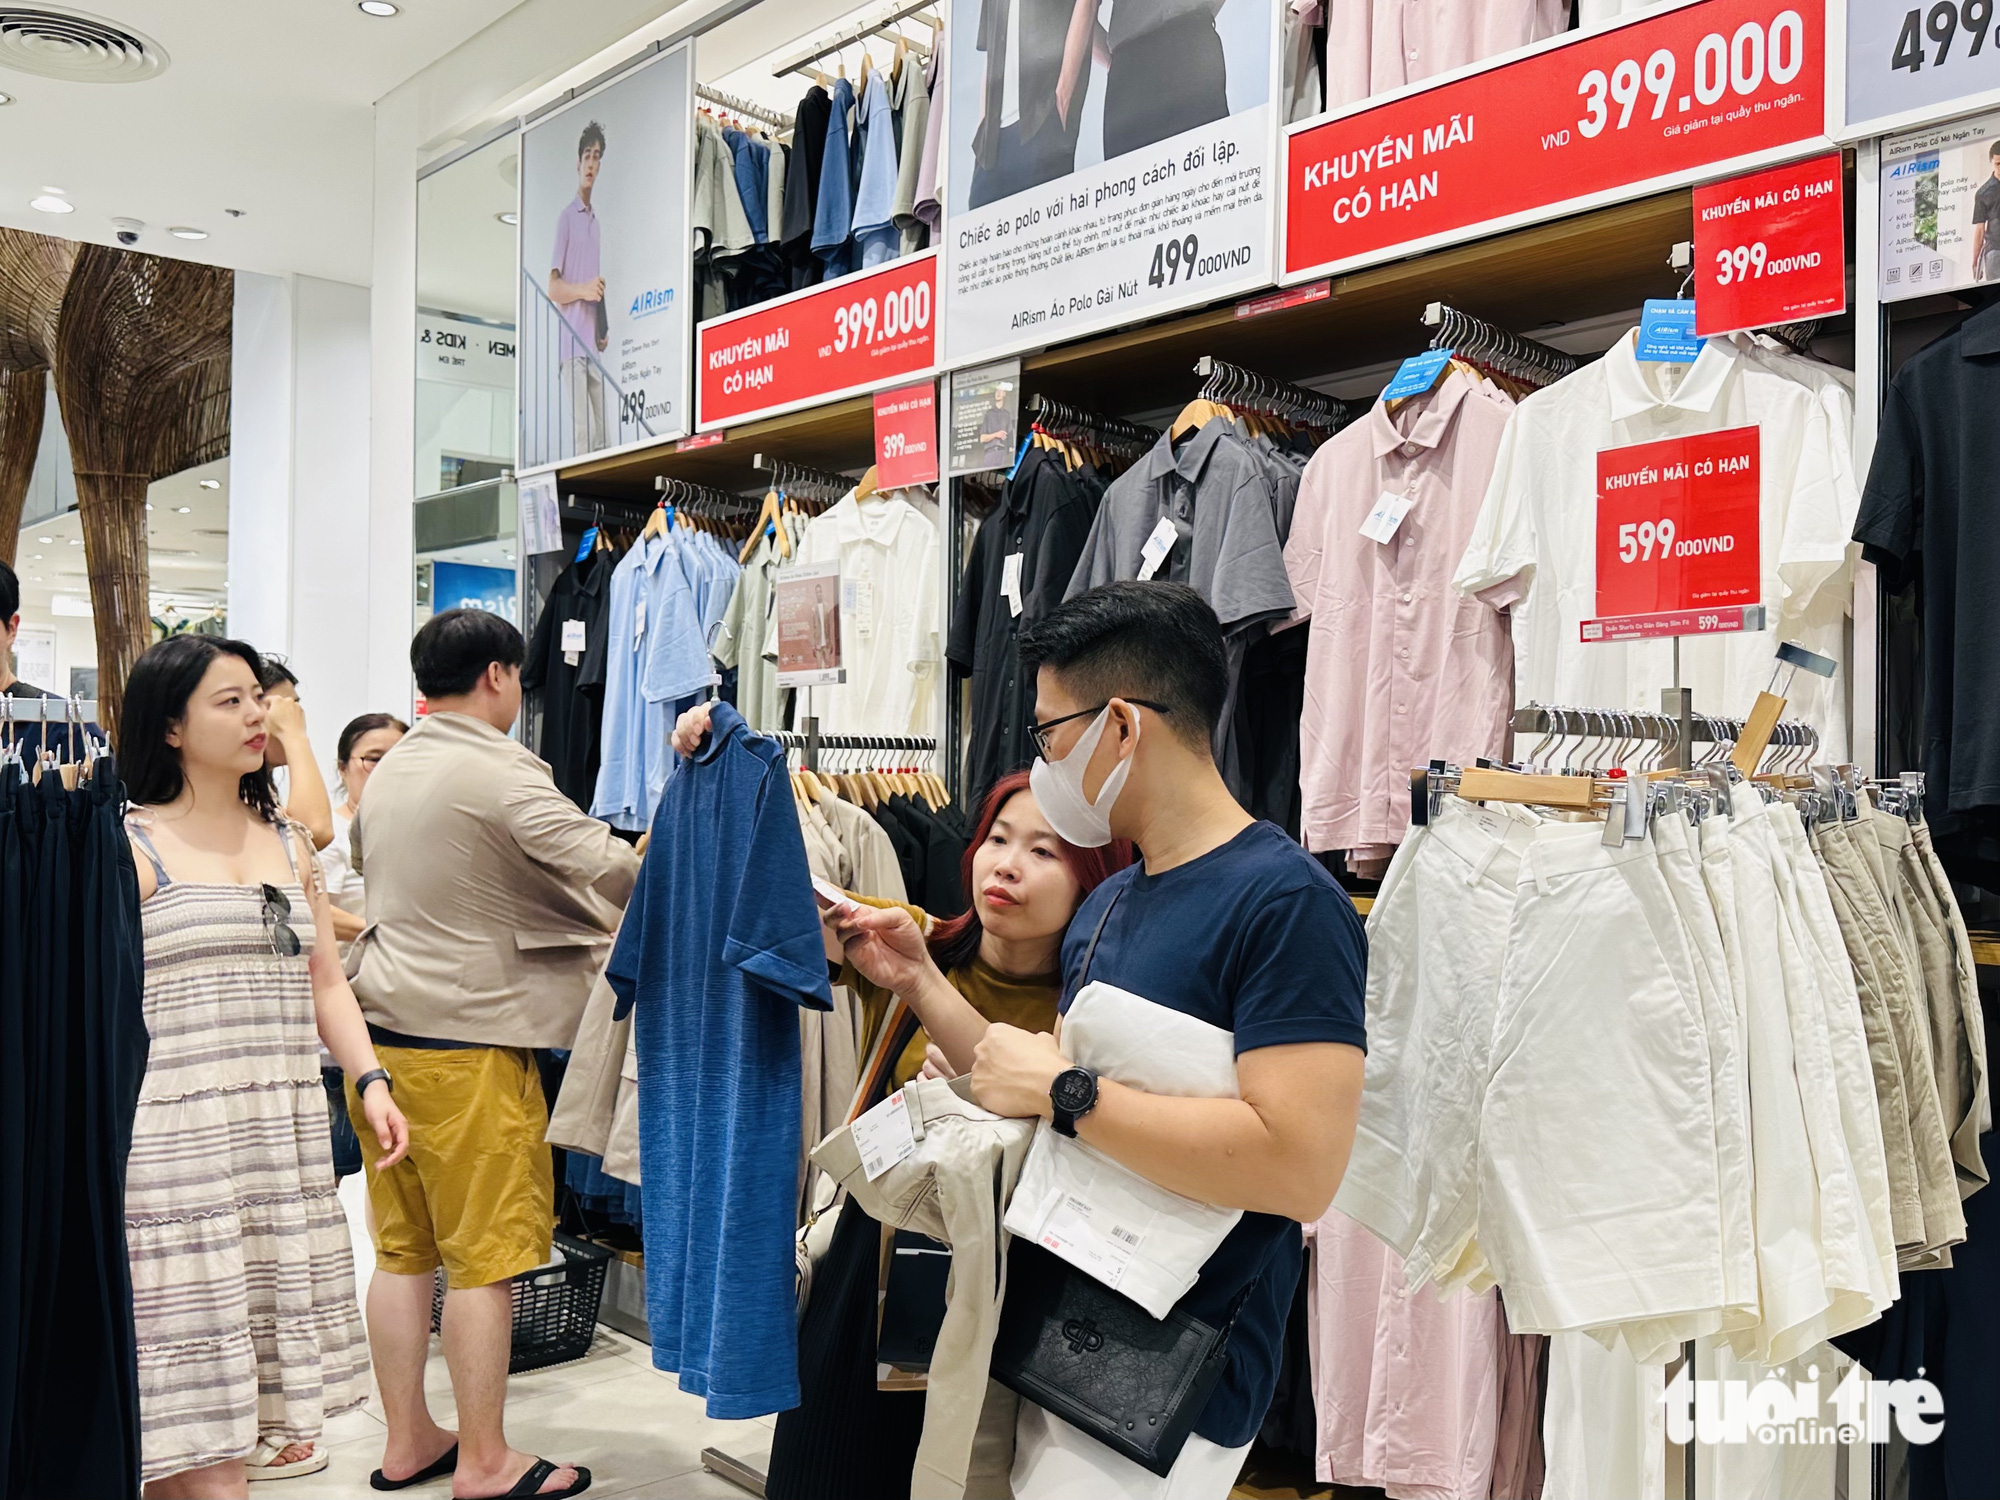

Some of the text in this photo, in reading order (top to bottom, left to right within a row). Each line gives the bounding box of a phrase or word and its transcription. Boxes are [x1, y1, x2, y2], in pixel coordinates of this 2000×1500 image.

[1541, 10, 1804, 151] VND 399.000
[1663, 124, 1681, 137] Giá
[1683, 118, 1708, 134] giảm
[1710, 113, 1724, 125] tại
[1726, 105, 1752, 122] quầy
[1754, 102, 1771, 113] thu
[1303, 112, 1474, 190] KHUYẾN MÃI
[1889, 145, 1912, 156] AIRism
[1913, 140, 1928, 150] Polo
[1972, 127, 1986, 136] Tay
[1889, 159, 1941, 179] AIRism
[959, 140, 1239, 249] Chiếc áo polo với hai phong cách đối lập.
[1332, 171, 1438, 225] CÓ HẠN
[1702, 179, 1834, 221] KHUYẾN MÃI CÓ HẠN
[629, 288, 674, 316] AIRism
[833, 280, 931, 353] 399.000
[1010, 309, 1046, 330] AIRism
[1050, 299, 1065, 319] Áo
[1069, 293, 1093, 314] Polo
[1096, 287, 1114, 306] Gài
[1118, 279, 1138, 300] Nút
[709, 327, 832, 370] KHUYẾN MÃI VND
[722, 364, 774, 395] CÓ HẠN
[1605, 455, 1750, 491] KHUYẾN MÃI CÓ HẠN
